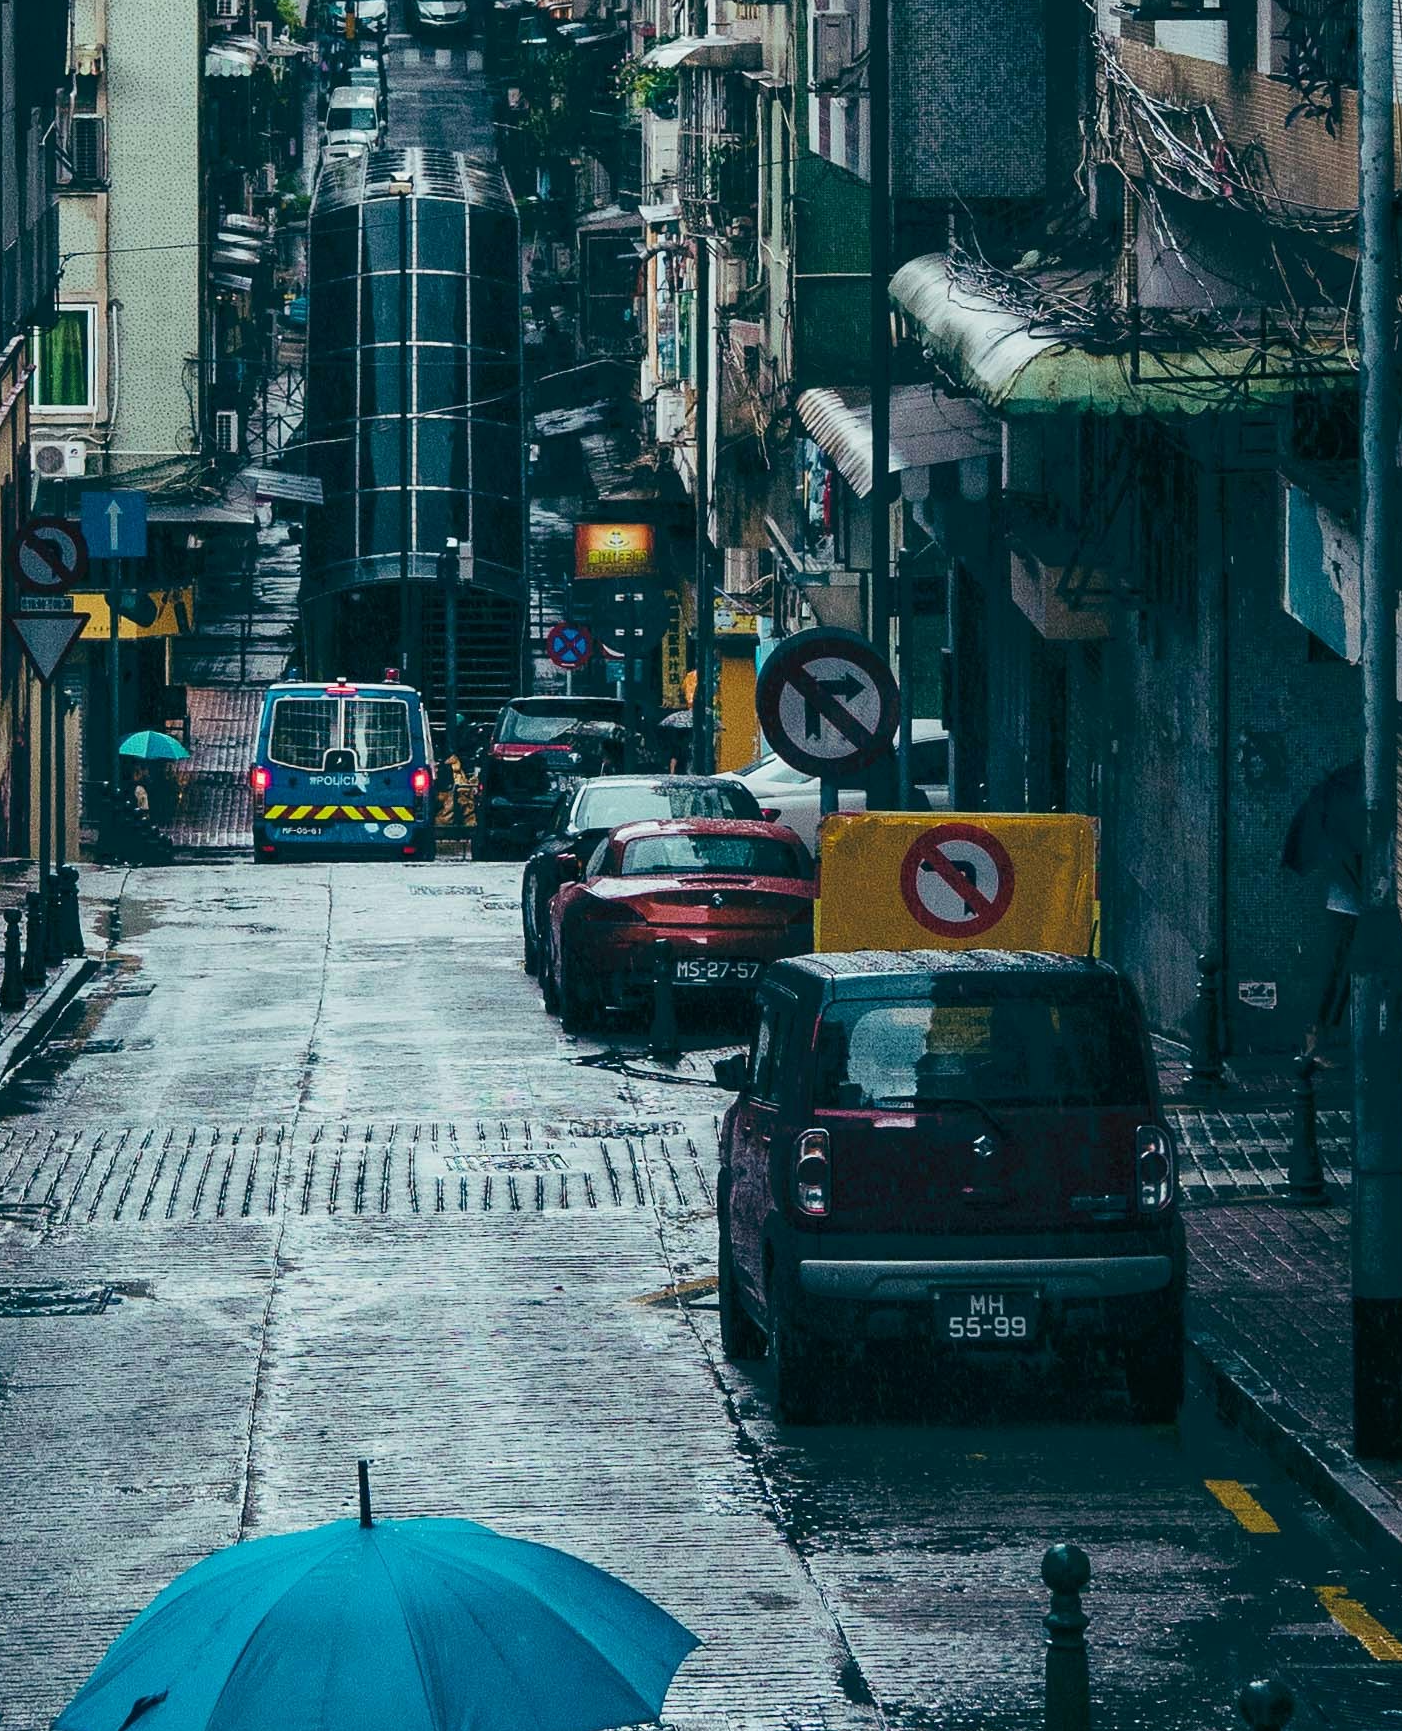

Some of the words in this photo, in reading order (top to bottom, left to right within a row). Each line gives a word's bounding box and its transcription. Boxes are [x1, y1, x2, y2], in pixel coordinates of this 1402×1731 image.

[677, 961, 760, 979] MS-27-57
[970, 1294, 1004, 1315] MH
[949, 1316, 1026, 1337] 55-99
